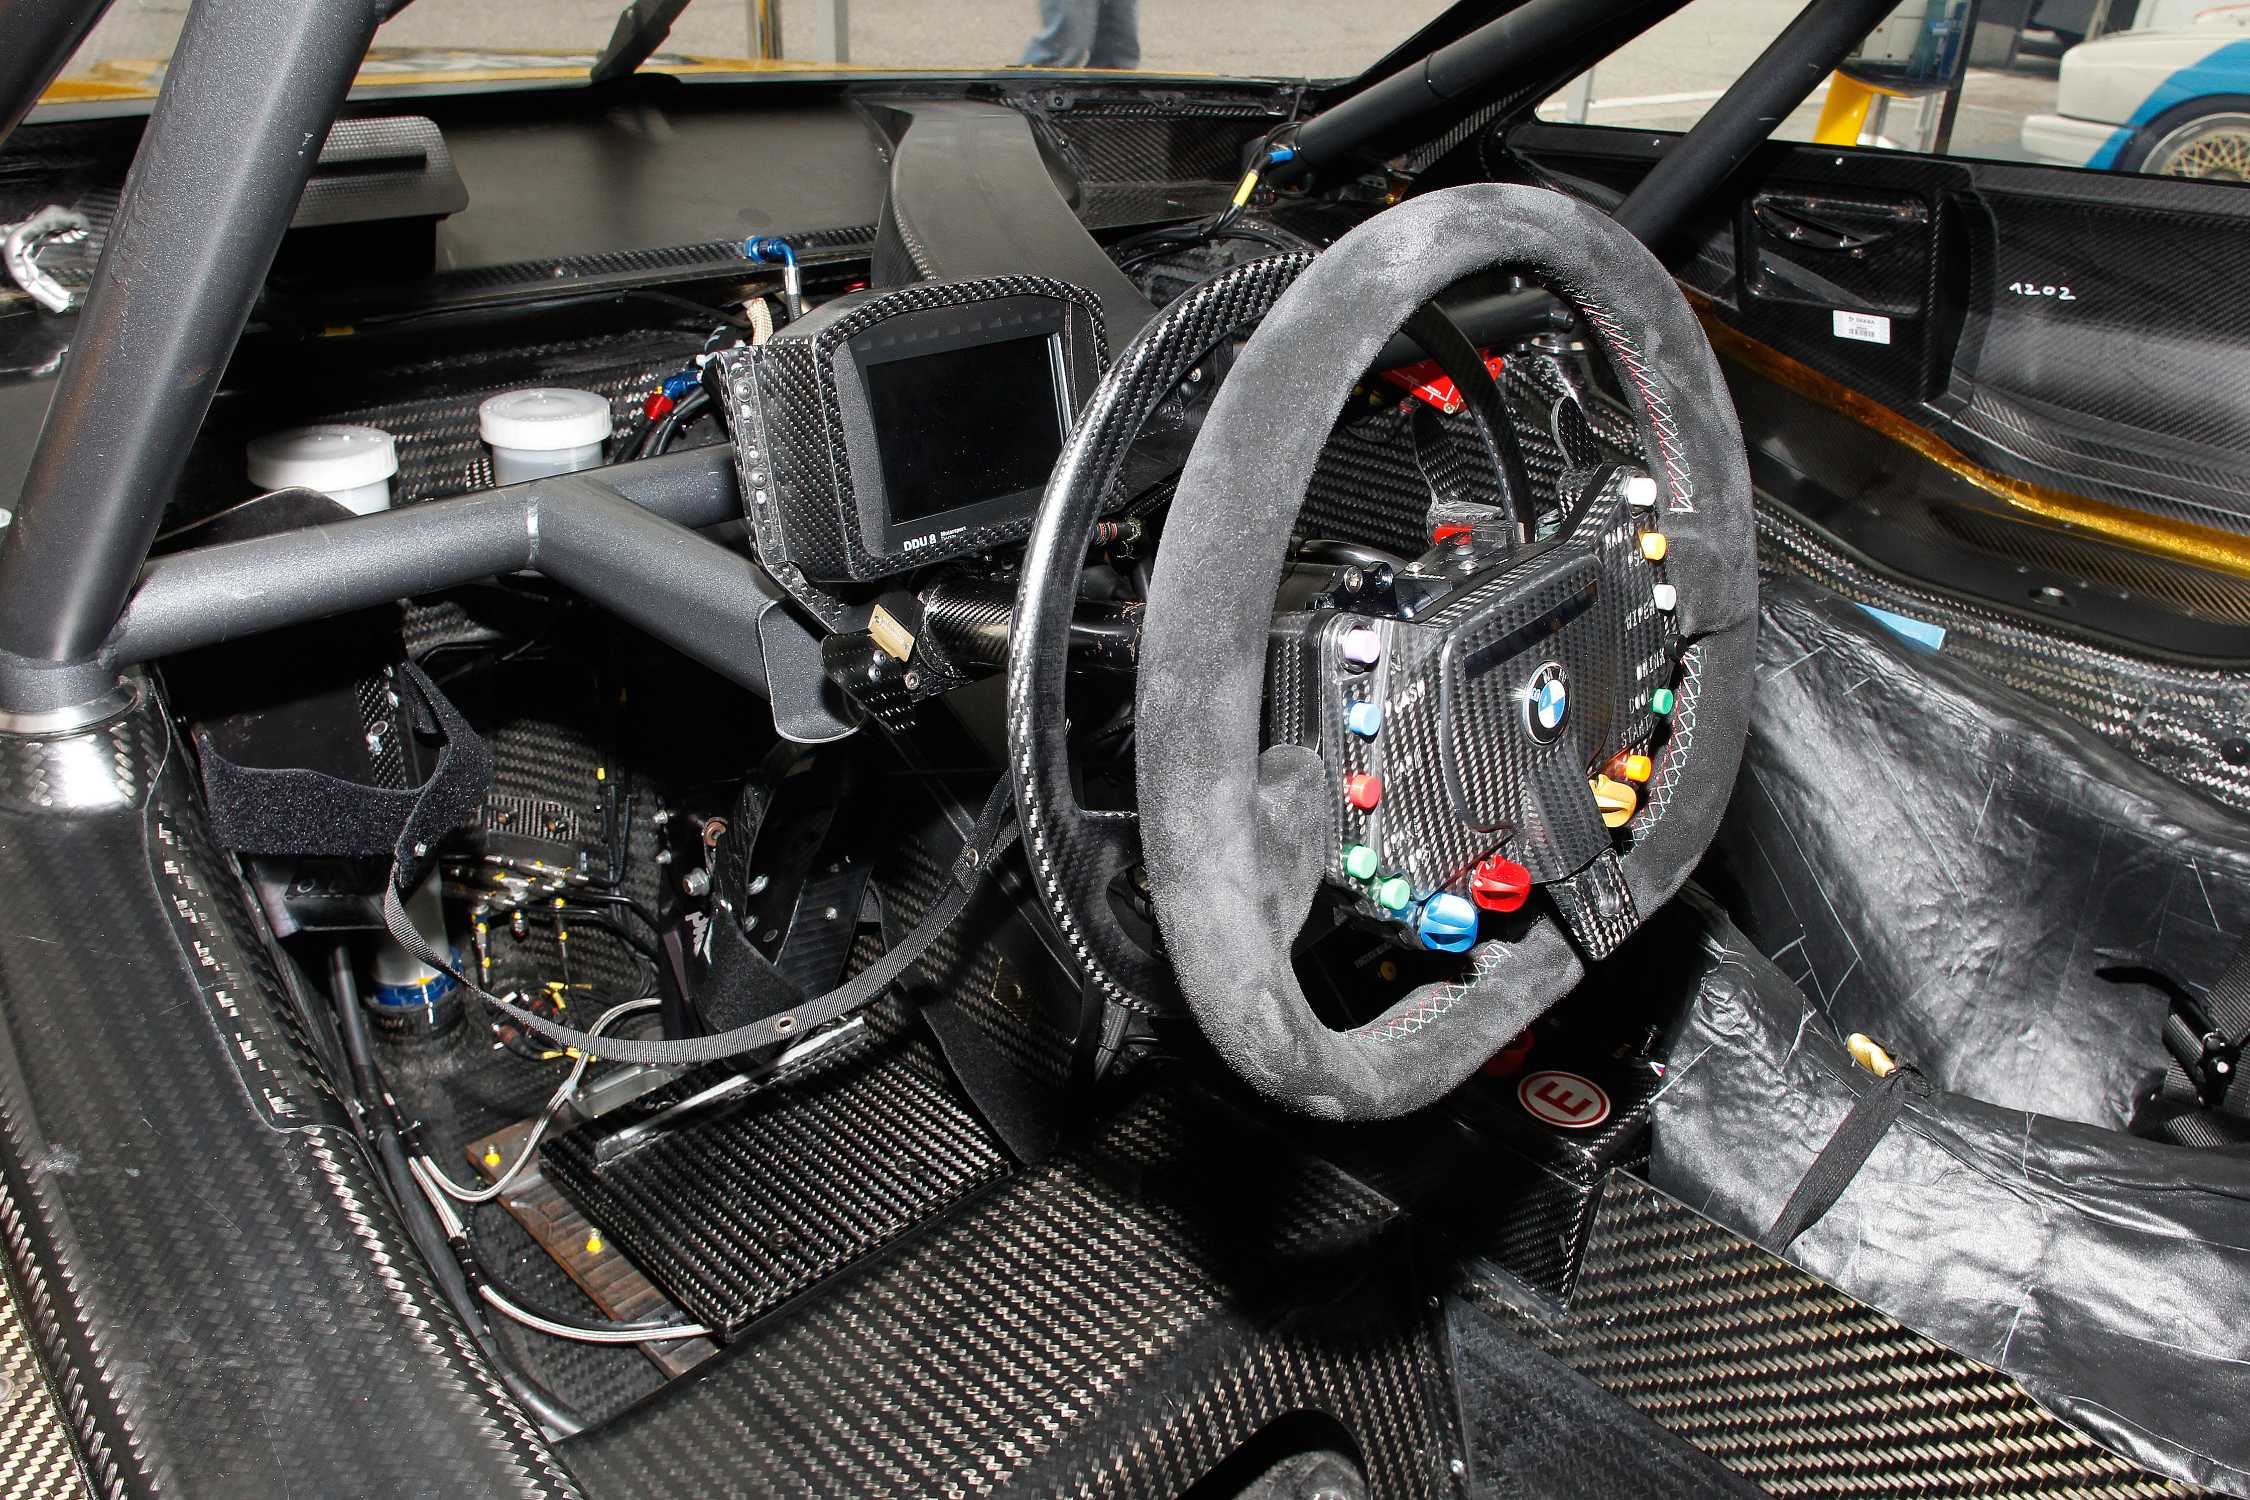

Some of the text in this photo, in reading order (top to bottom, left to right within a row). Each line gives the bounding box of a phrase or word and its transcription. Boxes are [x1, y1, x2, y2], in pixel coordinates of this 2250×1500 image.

[2009, 282, 2076, 300] 1202
[904, 536, 928, 551] DDU
[929, 534, 937, 545] 8
[1625, 599, 1655, 631] WIPER
[1636, 647, 1666, 681] DRINK
[1629, 686, 1653, 714] COOL
[1621, 713, 1650, 748] START
[1534, 1080, 1594, 1117] E
